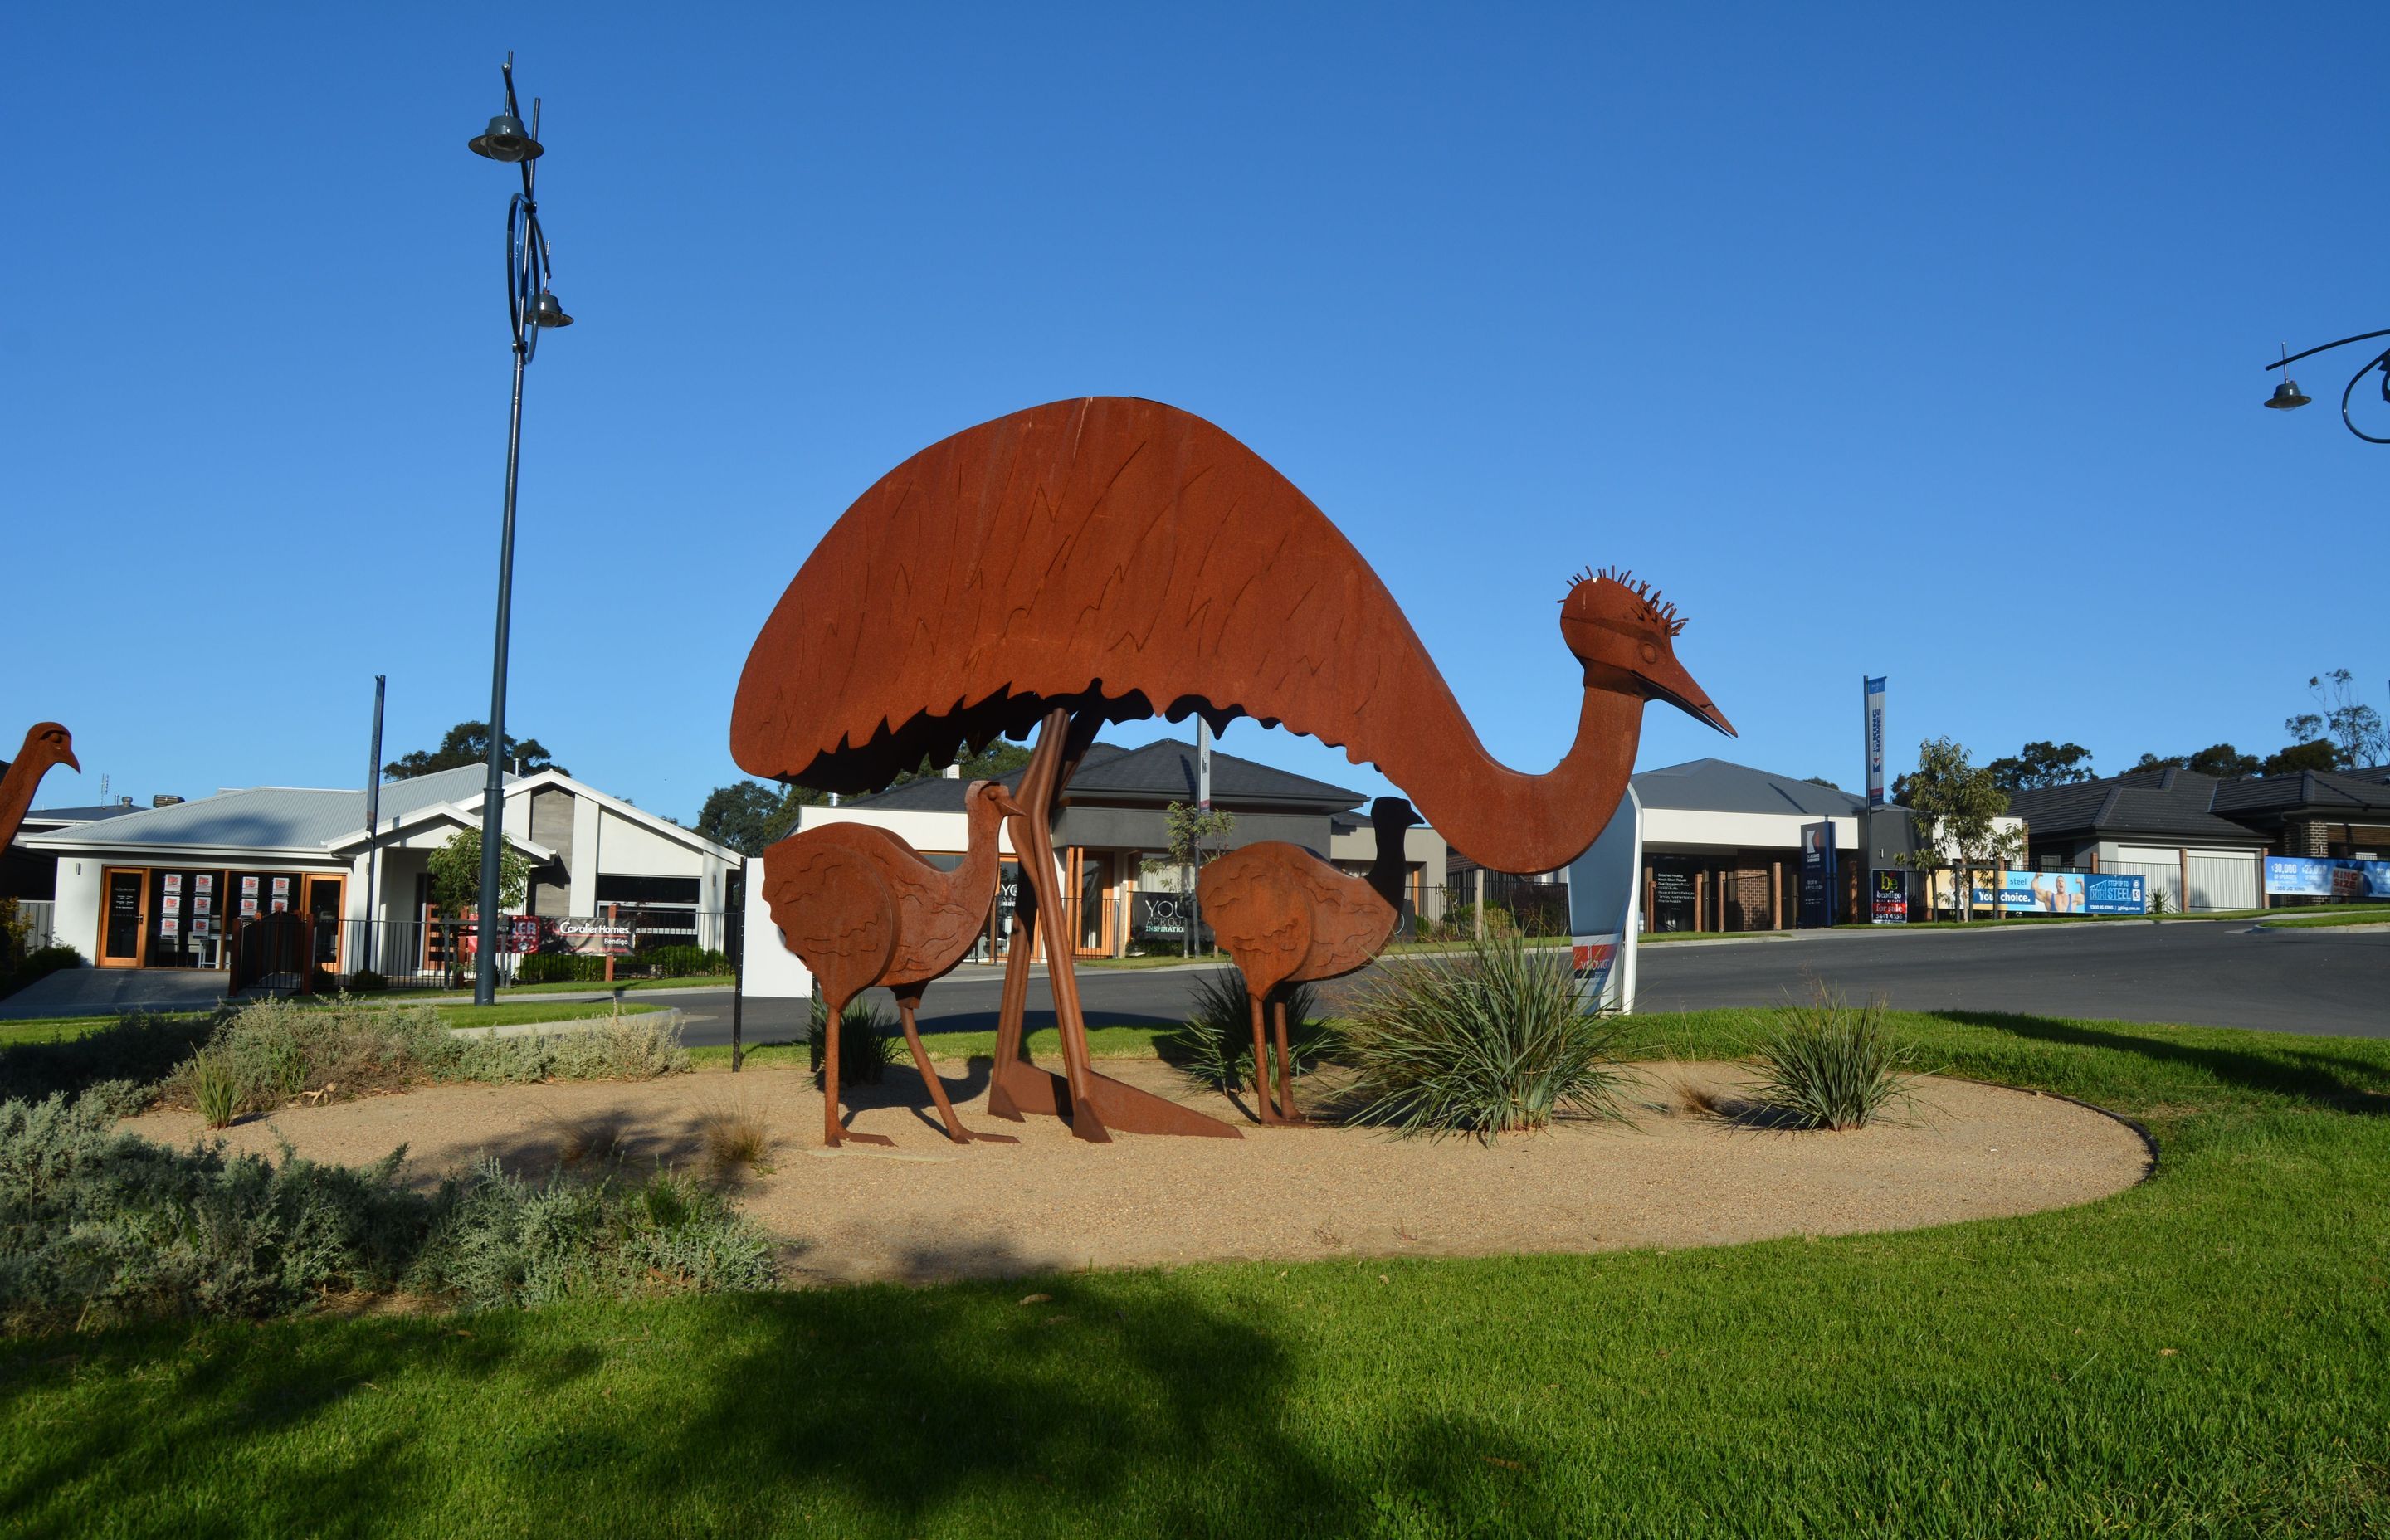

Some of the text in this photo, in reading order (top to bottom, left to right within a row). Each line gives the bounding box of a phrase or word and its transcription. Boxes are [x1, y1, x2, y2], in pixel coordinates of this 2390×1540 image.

[2333, 870, 2358, 881] KING
[2333, 880, 2357, 890] SIZE
[1876, 890, 1902, 899] bendigo
[1978, 891, 2031, 902] You choice.
[2108, 887, 2131, 900] STEEL
[1875, 903, 1903, 913] for sale
[559, 920, 630, 934] Cavalier Homes
[1168, 917, 1185, 927] OU
[603, 938, 628, 946] Bendigo
